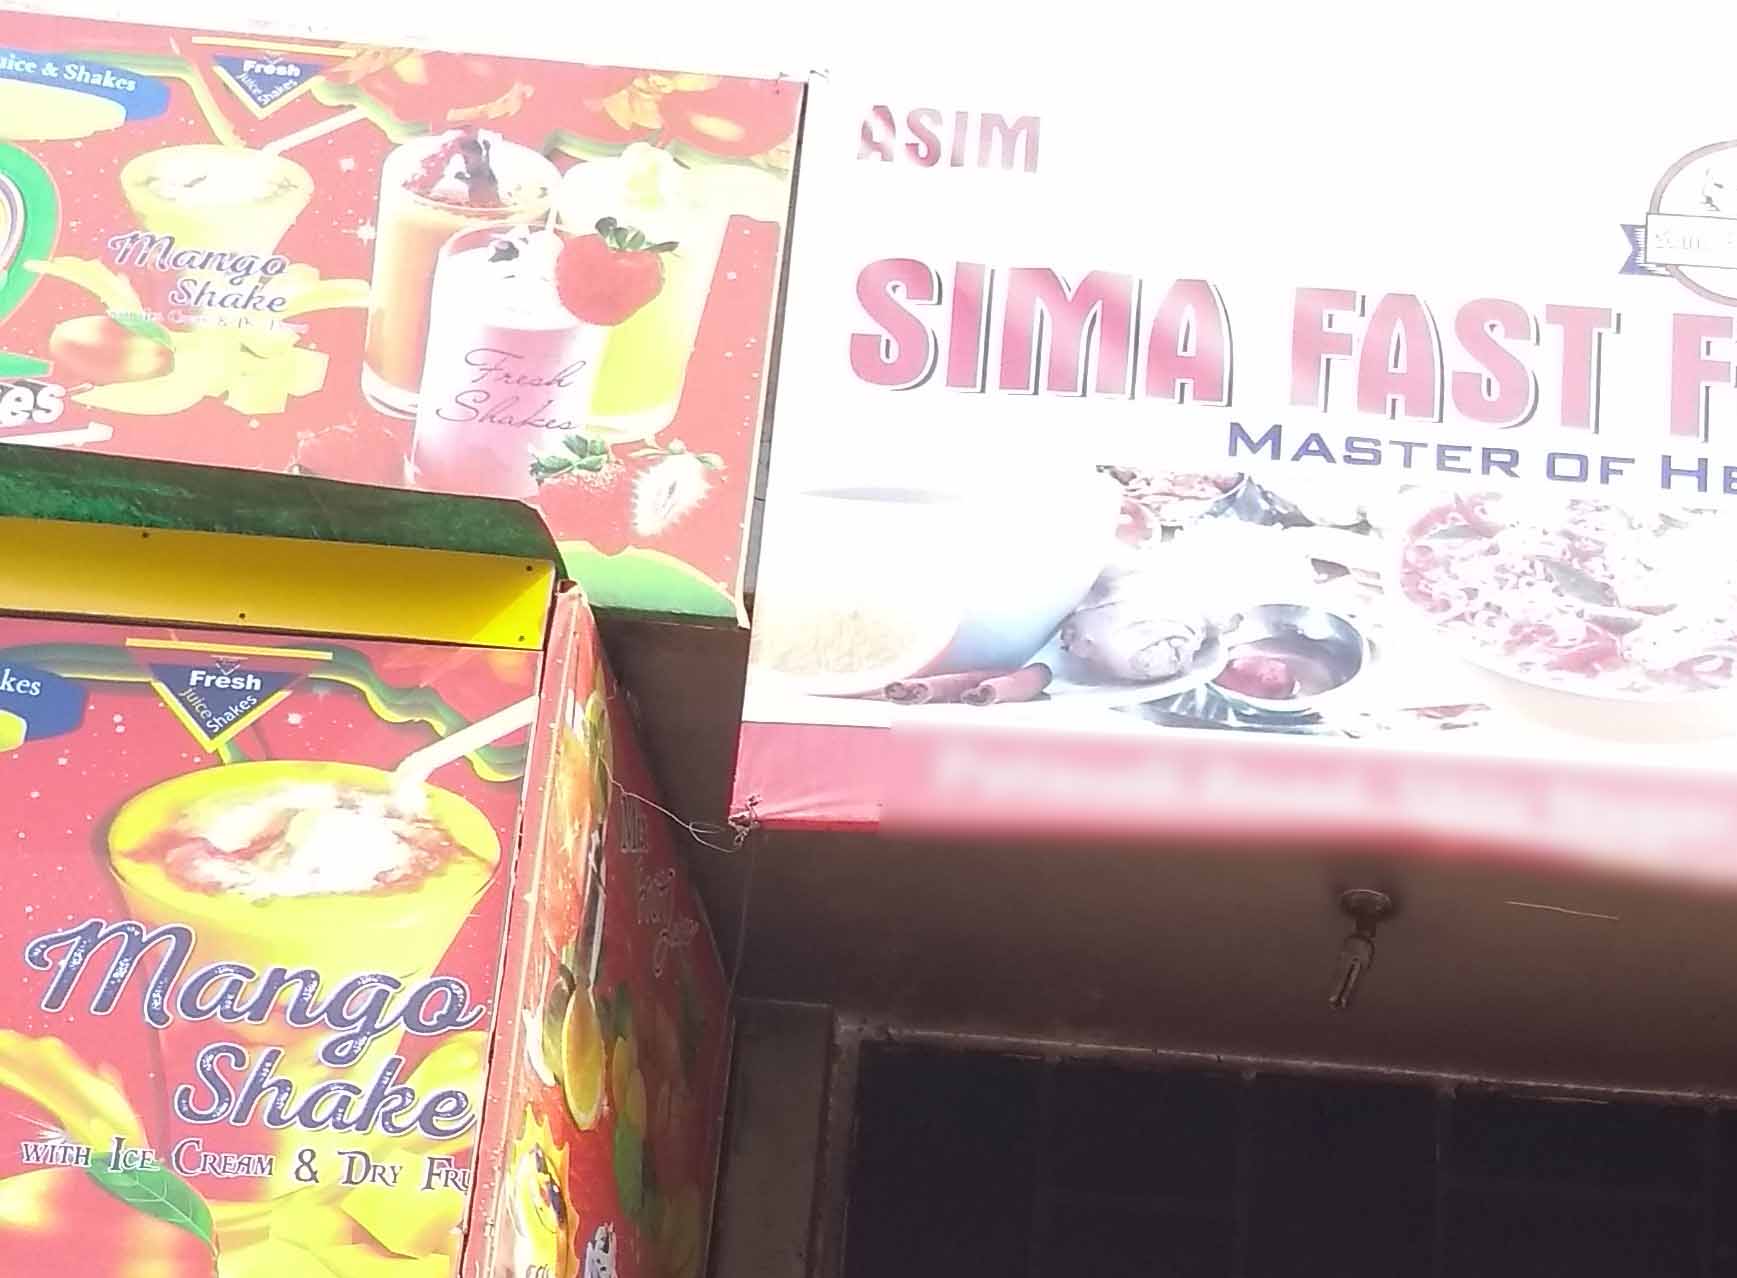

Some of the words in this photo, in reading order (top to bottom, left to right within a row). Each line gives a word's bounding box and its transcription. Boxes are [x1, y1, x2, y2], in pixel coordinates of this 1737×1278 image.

[41, 62, 59, 77] &
[63, 64, 137, 91] Shakes
[243, 60, 300, 77] Fresh
[857, 105, 1041, 173] ASIM
[108, 231, 288, 285] Mango
[169, 278, 287, 313] Shake
[464, 347, 586, 388] Fresh
[849, 257, 1232, 407] SIMA
[1290, 286, 1622, 434] FAST
[0, 380, 66, 427] es
[435, 389, 577, 431] Shakes
[1228, 421, 1521, 480] MASTER
[1546, 453, 1637, 485] OF
[189, 670, 262, 691] Fresh
[206, 695, 257, 733] Shakes
[25, 919, 486, 1066] Mango
[174, 1041, 476, 1139] Shake
[22, 1141, 92, 1169] WITH
[110, 1137, 160, 1171] ICE
[171, 1140, 274, 1176] CREAM
[294, 1149, 320, 1183] &
[338, 1151, 402, 1184] DRY
